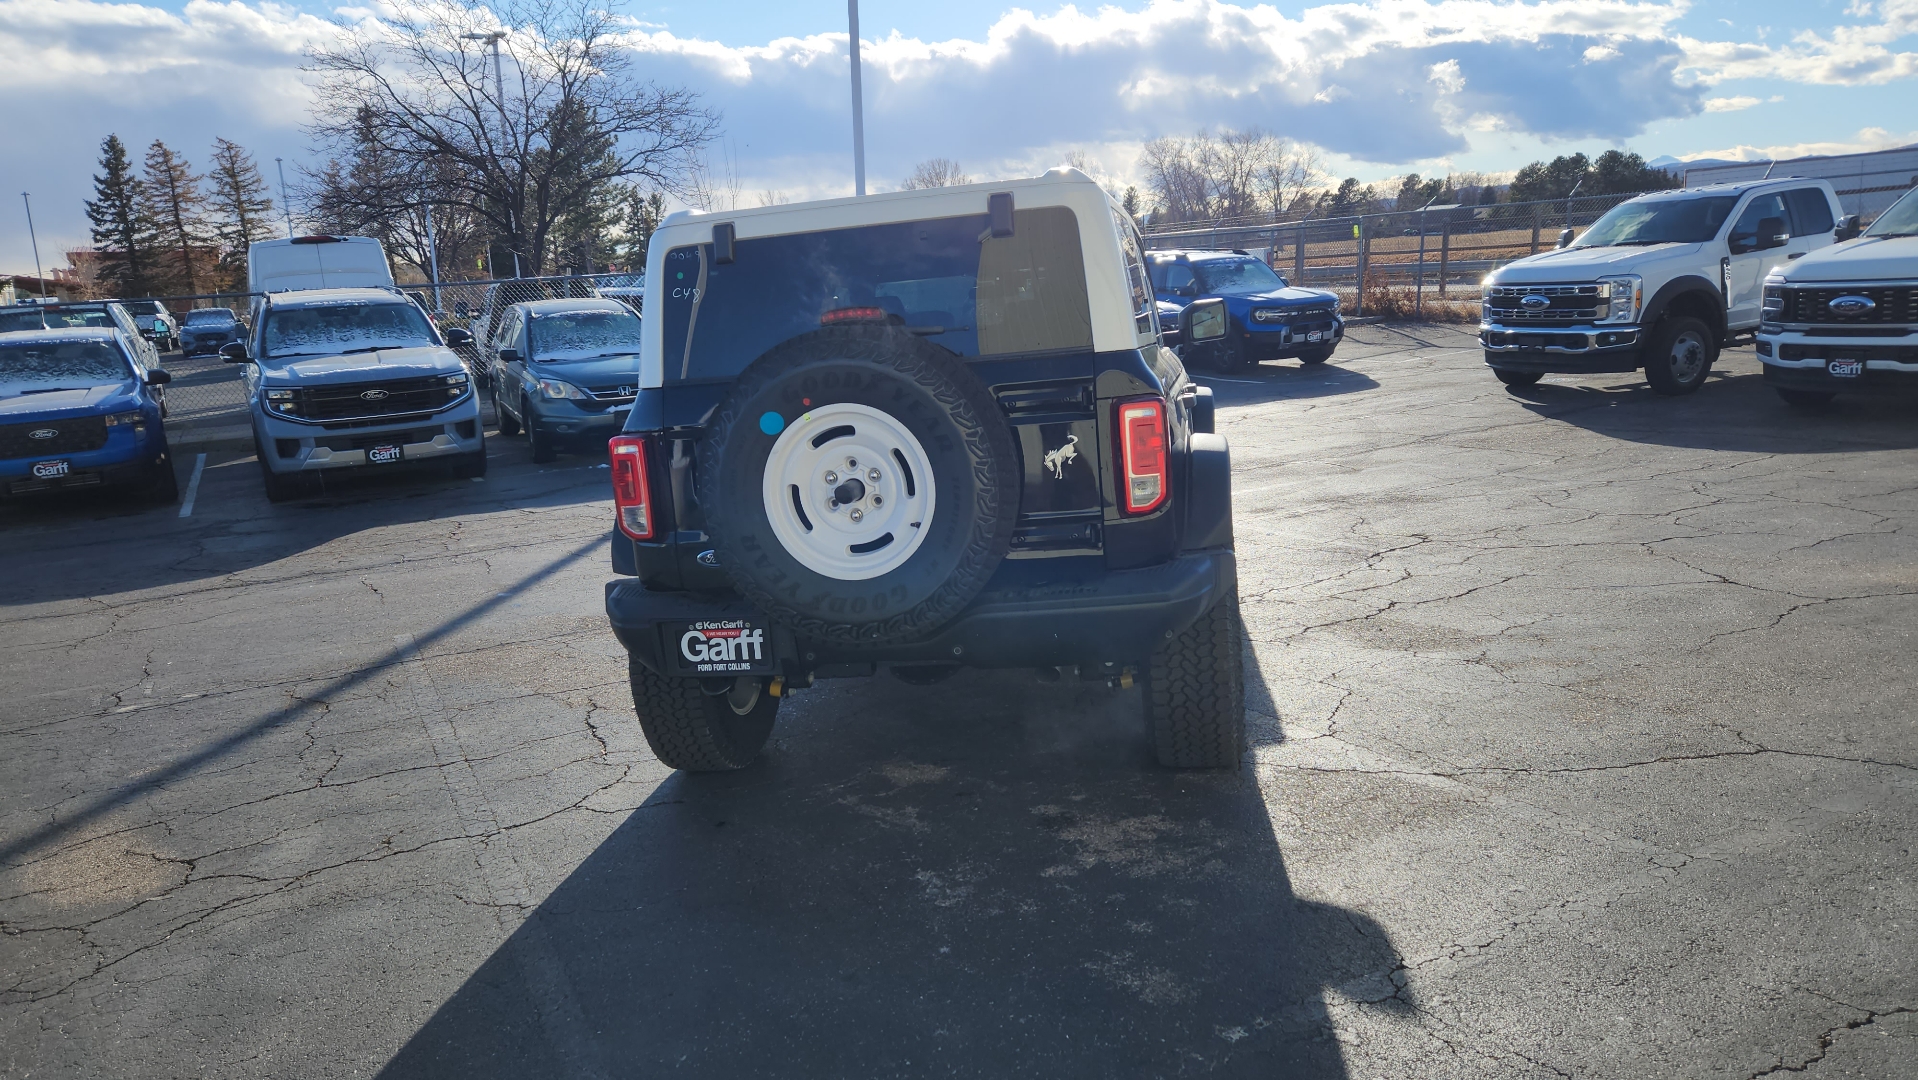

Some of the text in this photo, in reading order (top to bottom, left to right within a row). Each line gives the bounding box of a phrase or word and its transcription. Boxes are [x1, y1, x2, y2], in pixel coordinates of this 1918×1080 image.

[1828, 361, 1863, 375] Garff
[369, 447, 400, 461] Garff
[33, 462, 69, 477] Garff
[703, 619, 744, 630] Ken Garff
[681, 628, 764, 662] Garff
[697, 662, 751, 672] FORD FORT COLLINS
